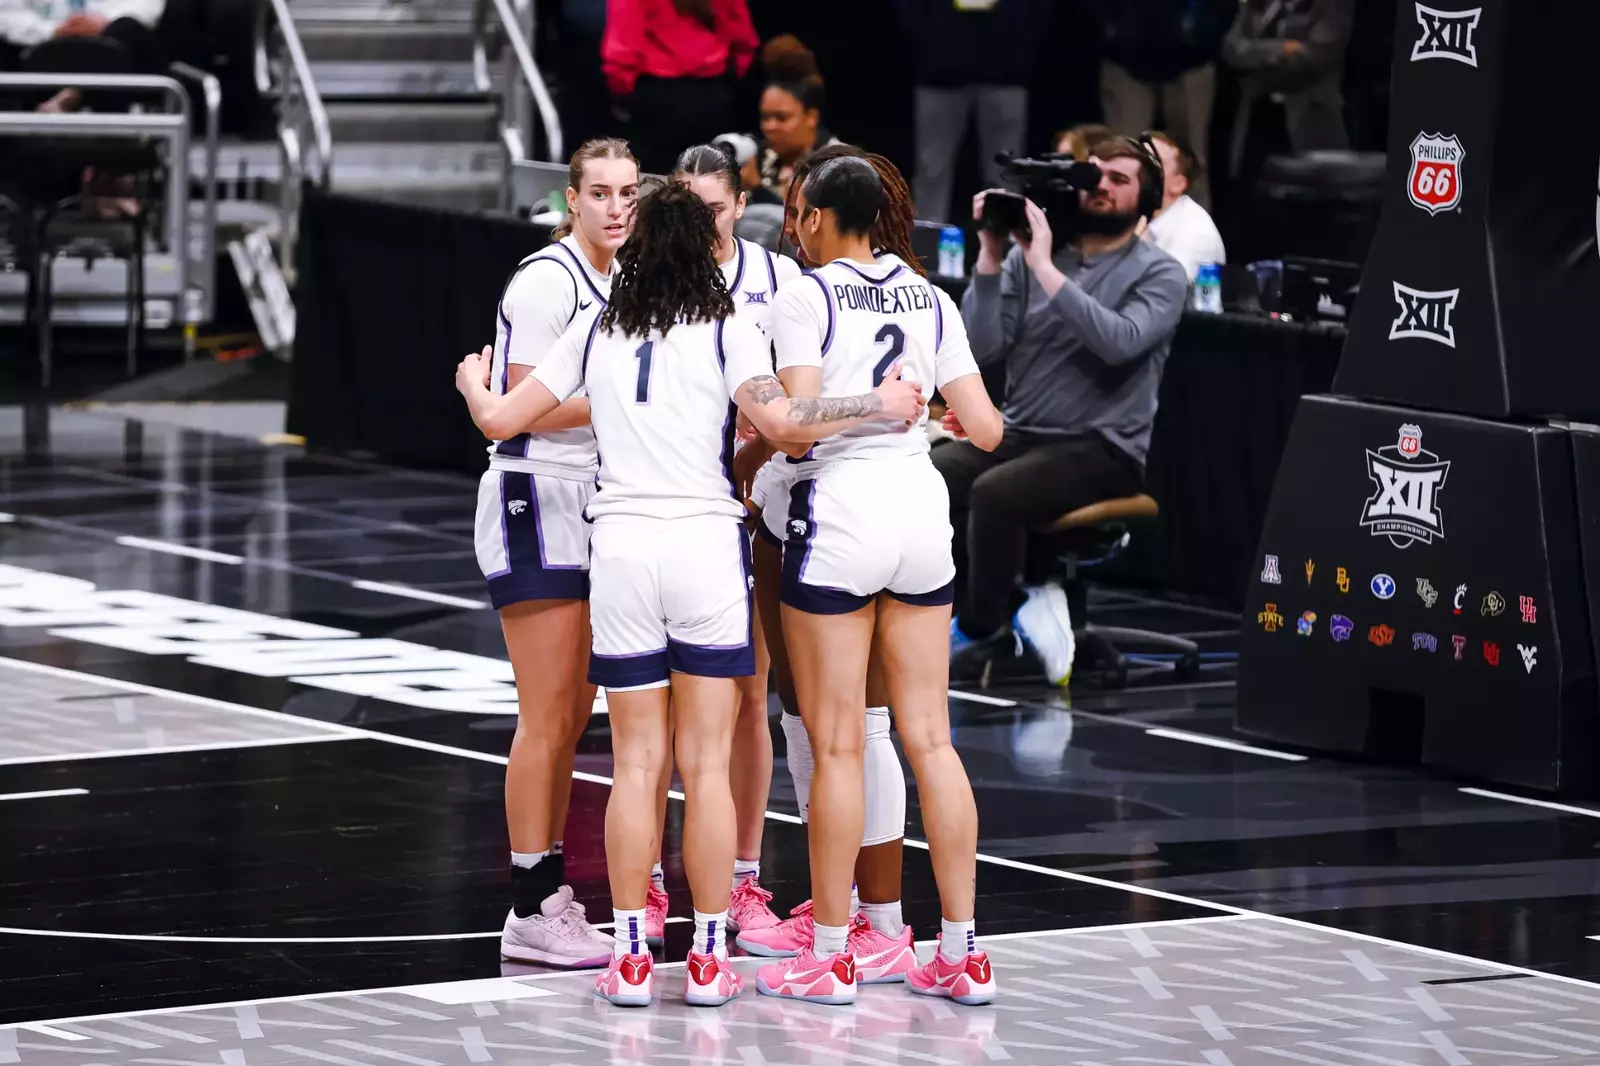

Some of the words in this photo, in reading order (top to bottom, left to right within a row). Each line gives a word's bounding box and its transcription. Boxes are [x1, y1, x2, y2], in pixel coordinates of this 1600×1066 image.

[1418, 144, 1457, 161] PHILLIPS
[1417, 166, 1452, 197] 66
[833, 284, 933, 314] POINDEXTER
[872, 323, 905, 388] 2
[634, 340, 655, 403] 1
[1402, 438, 1417, 451] 66
[1376, 523, 1428, 537] CHAMPIONSHIP
[1412, 632, 1438, 653] TCU
